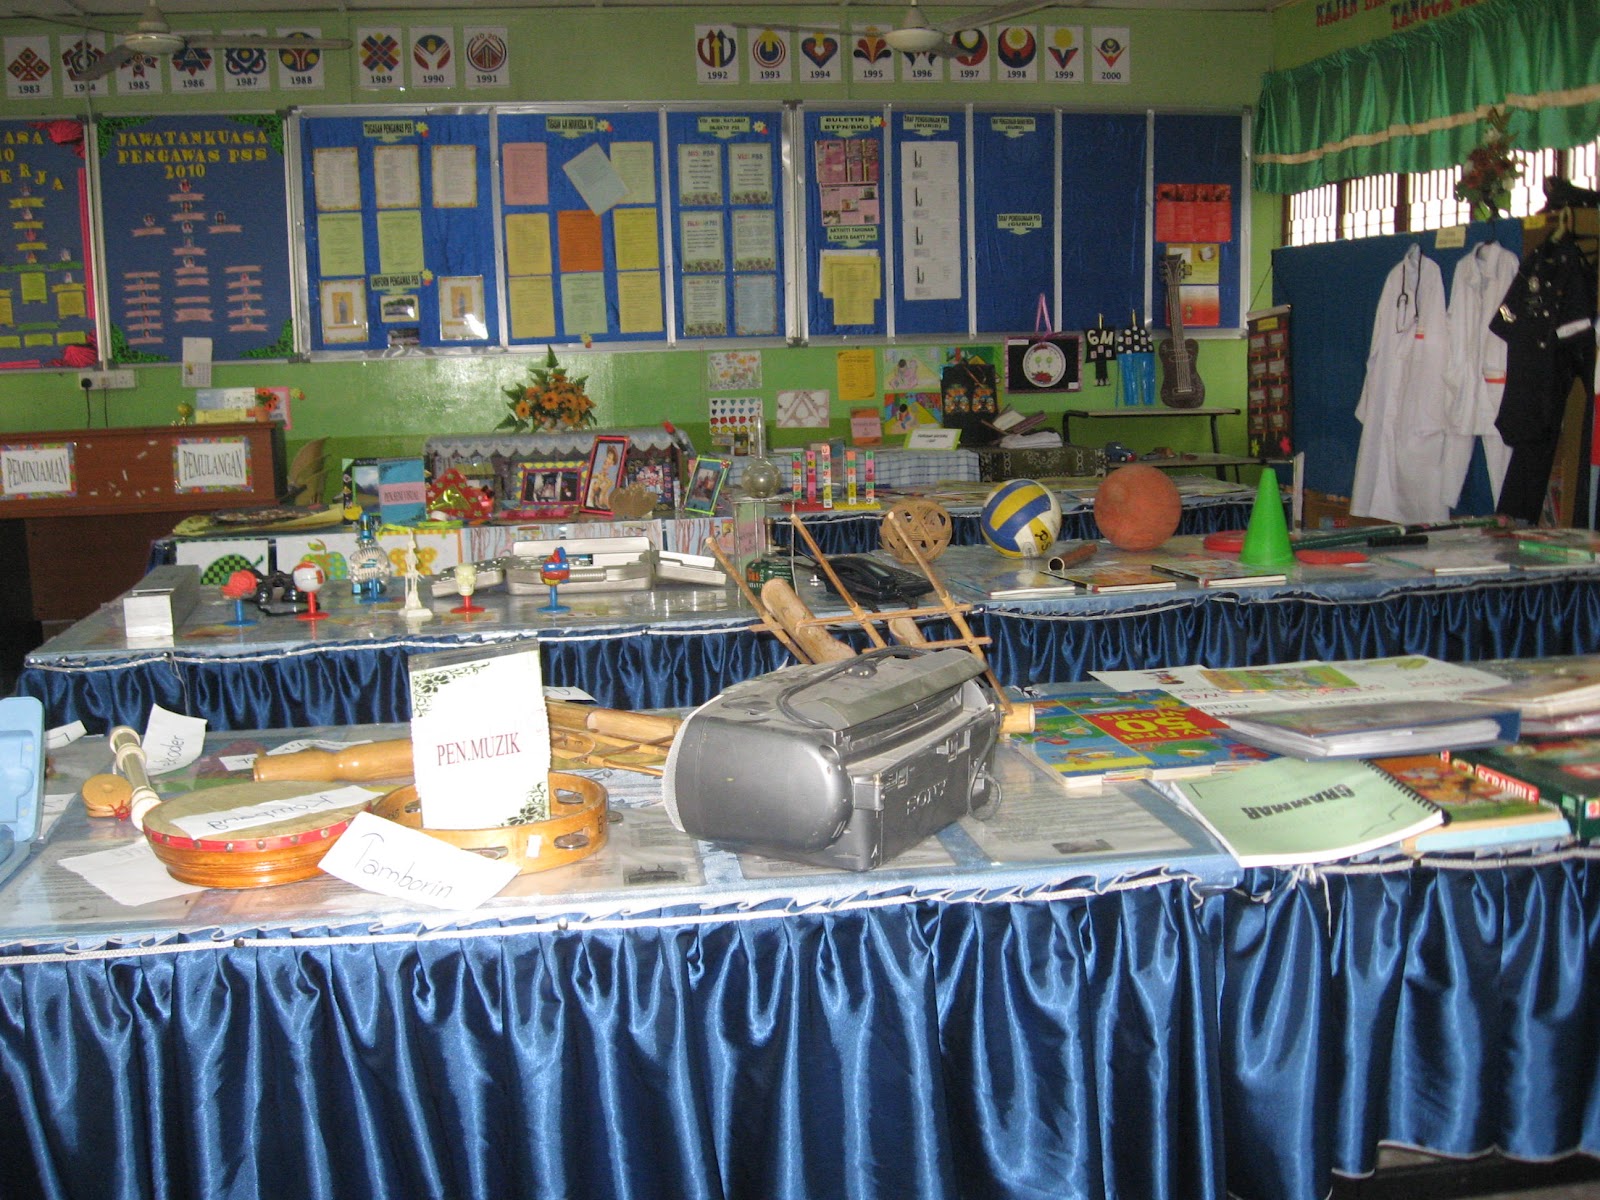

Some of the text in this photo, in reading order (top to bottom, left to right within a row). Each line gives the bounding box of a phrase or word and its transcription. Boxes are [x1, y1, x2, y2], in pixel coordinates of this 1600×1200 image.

[423, 74, 444, 83] 1990
[476, 74, 498, 83] 1991
[708, 72, 728, 80] 1992
[760, 70, 780, 78] 1993
[810, 70, 830, 78] 1994
[864, 70, 884, 78] 1995
[1102, 72, 1122, 80] 2000
[183, 79, 205, 88] 1986
[236, 78, 258, 86] 1987
[291, 76, 312, 84] 1988
[371, 75, 392, 84] 1989
[18, 85, 40, 94] 1983
[74, 84, 96, 92] 194
[128, 82, 150, 90] 1985
[116, 130, 268, 147] JAWATANKUASA
[117, 148, 268, 165] PENGAWAS PSS
[164, 164, 206, 180] 2010
[1087, 329, 1114, 346] 6M
[182, 447, 244, 480] PEMULANGAN
[6, 456, 68, 488] PEMINJAMAN
[1115, 717, 1198, 733] 50
[436, 731, 521, 767] PEN.MUZIK
[1242, 783, 1356, 820] GRAMMAR
[354, 831, 454, 899] Tamborin
